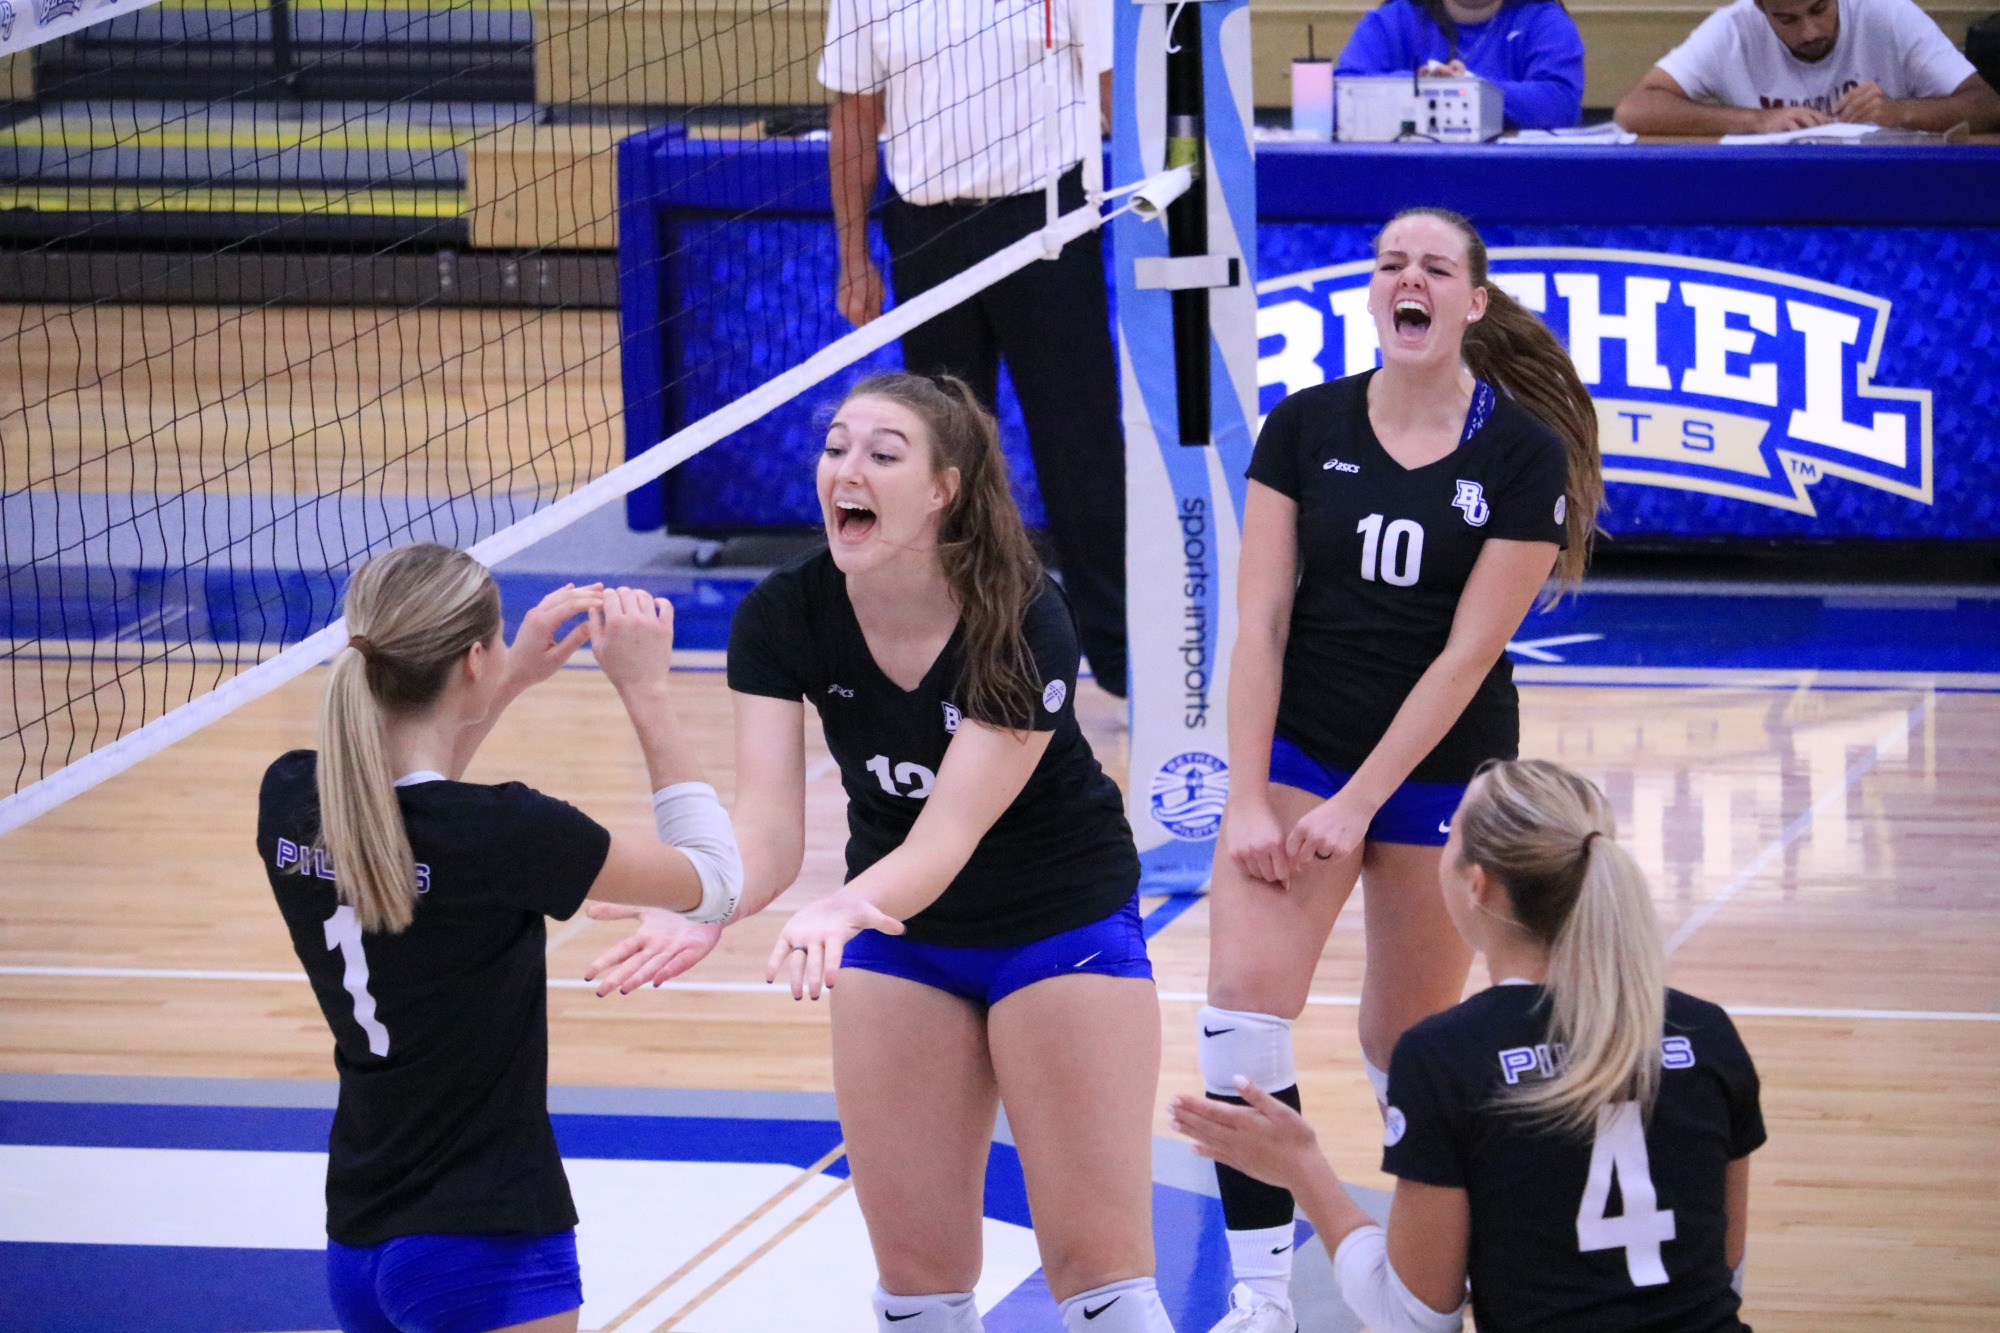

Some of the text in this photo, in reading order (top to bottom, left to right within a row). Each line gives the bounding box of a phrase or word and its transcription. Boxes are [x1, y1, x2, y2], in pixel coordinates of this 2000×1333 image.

[1256, 271, 1906, 469] BHEL
[1356, 513, 1425, 587] 10
[1451, 479, 1490, 527] BU
[1178, 498, 1211, 730] sports imports
[276, 837, 431, 894] PILS
[323, 904, 391, 1058] 1
[1498, 1036, 1696, 1085] PIS
[1576, 1100, 1676, 1288] 4
